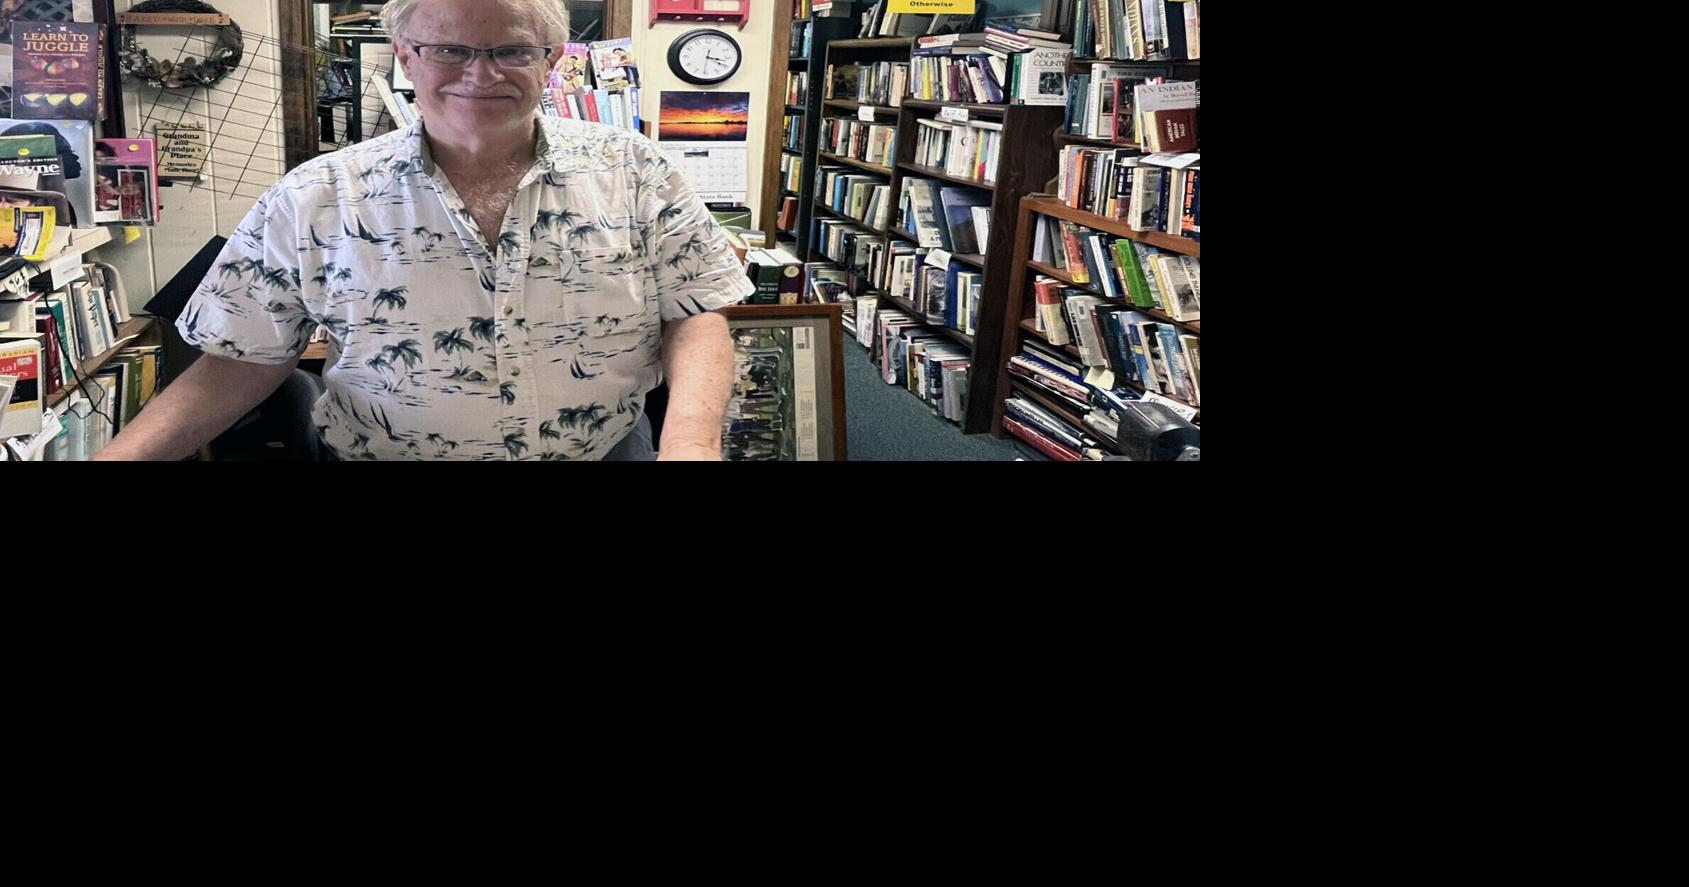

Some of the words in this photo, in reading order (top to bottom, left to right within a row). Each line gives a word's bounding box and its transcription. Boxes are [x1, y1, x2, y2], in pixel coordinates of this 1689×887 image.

[23, 32, 66, 41] LEARN
[70, 33, 89, 42] TO
[22, 41, 89, 52] JUGGLE
[0, 163, 60, 177] Wayne
